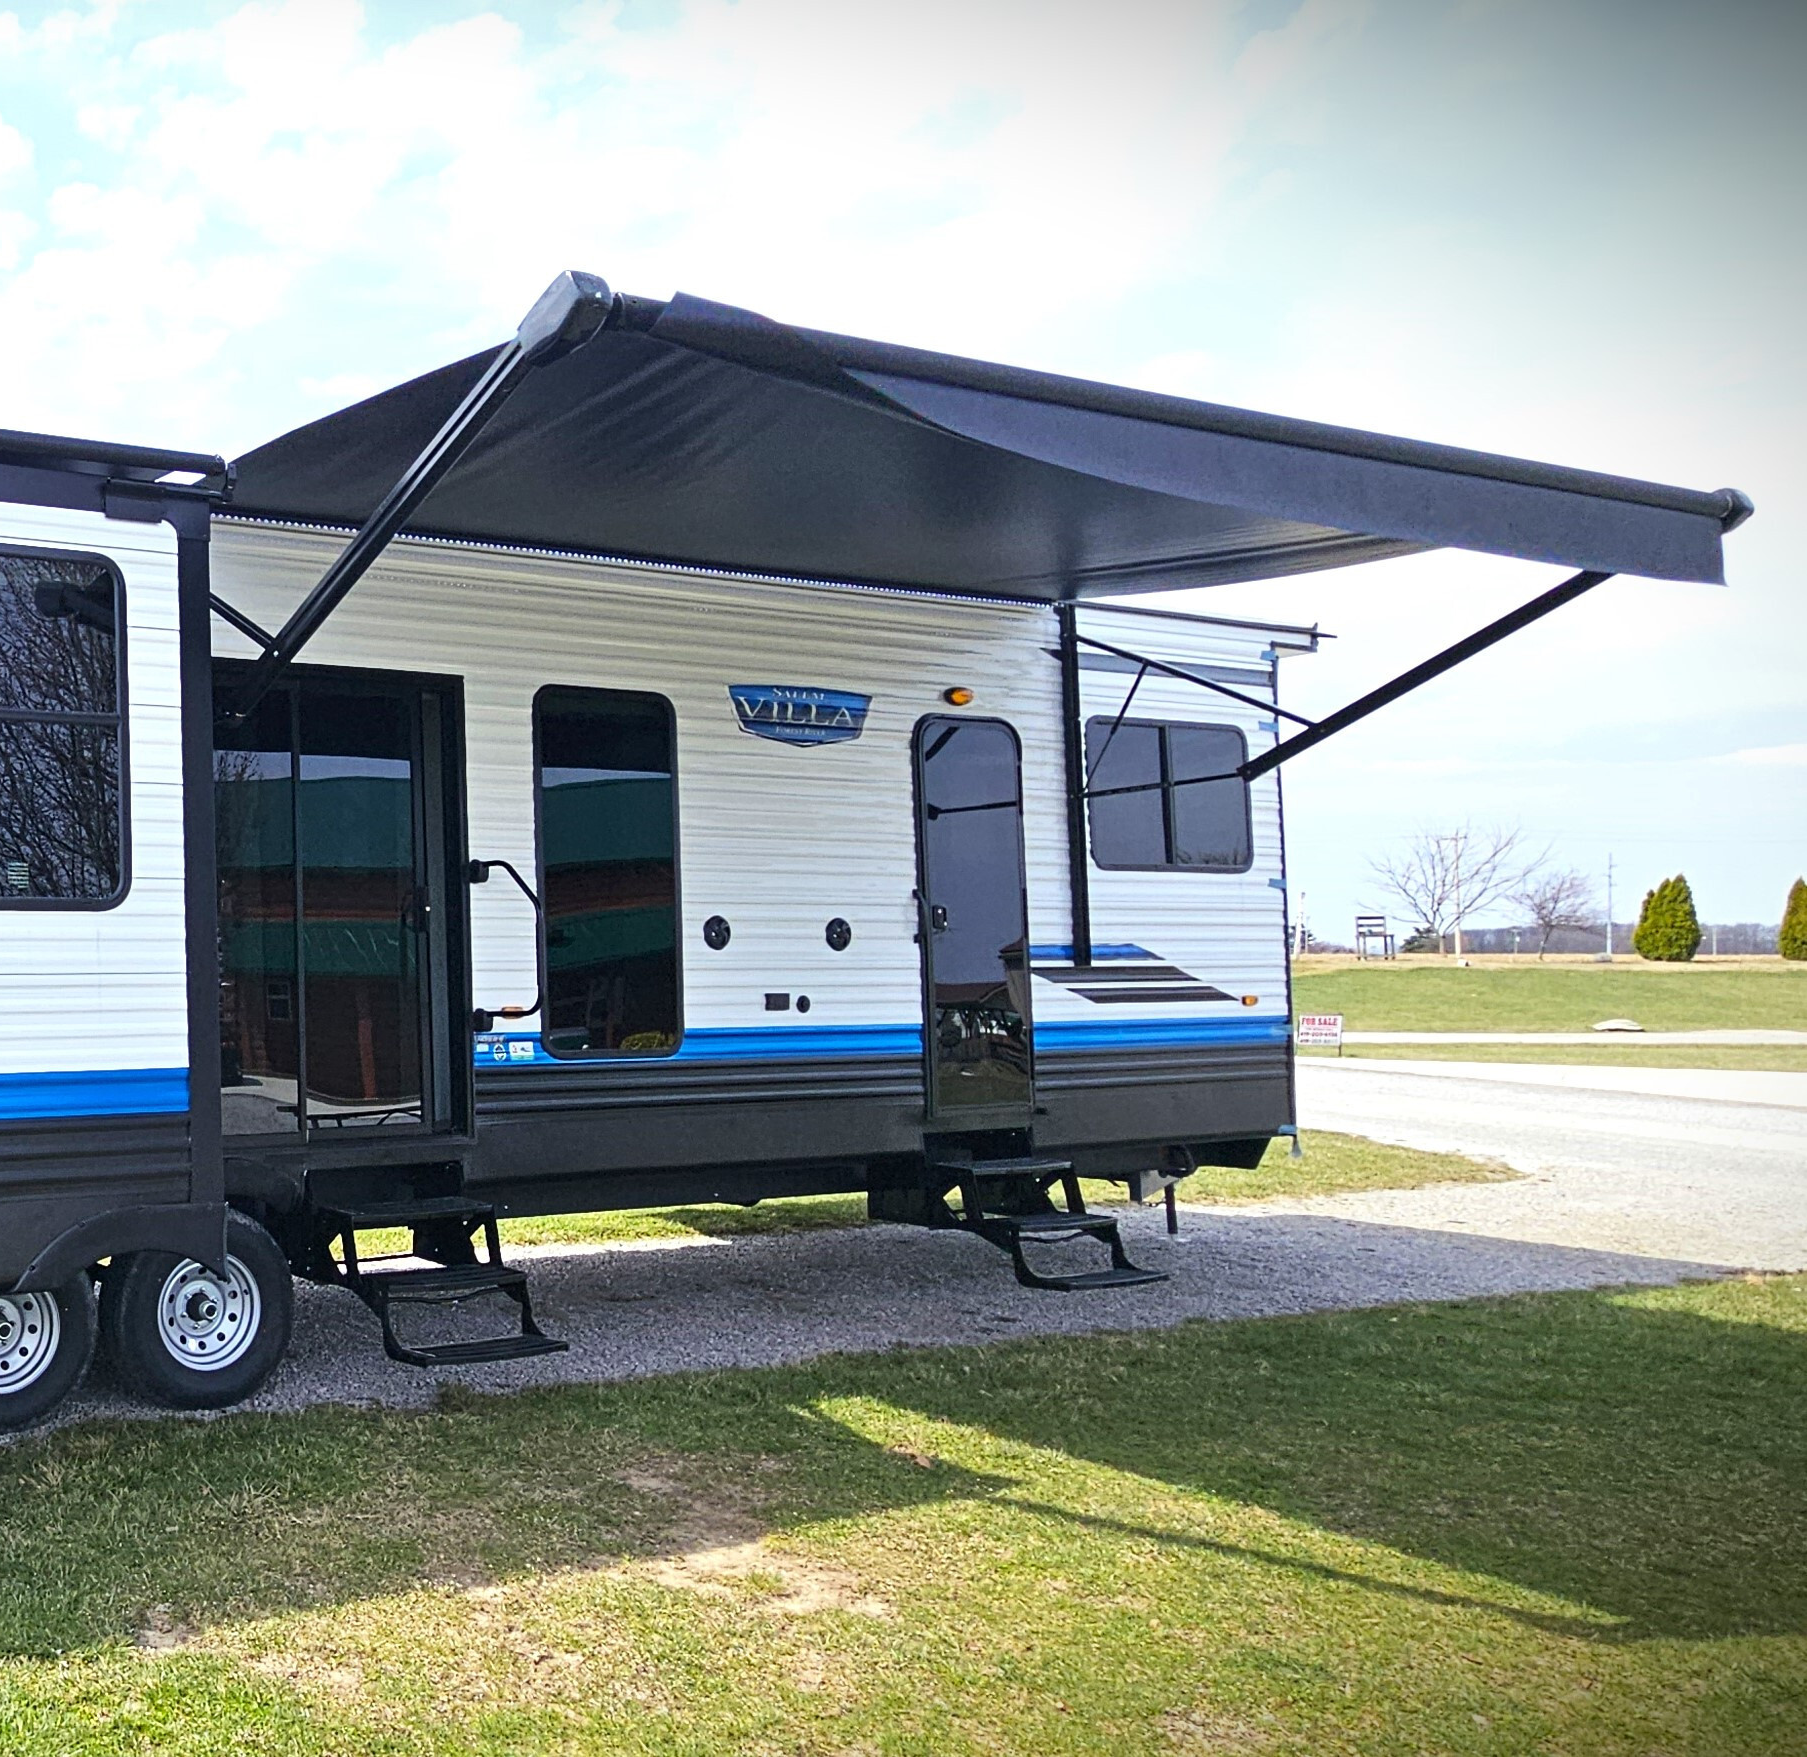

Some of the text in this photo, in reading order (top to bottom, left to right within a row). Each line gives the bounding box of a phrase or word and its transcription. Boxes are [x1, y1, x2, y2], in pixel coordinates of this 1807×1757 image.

[737, 696, 854, 726] VILLA
[1301, 1017, 1338, 1025] FOR SALE
